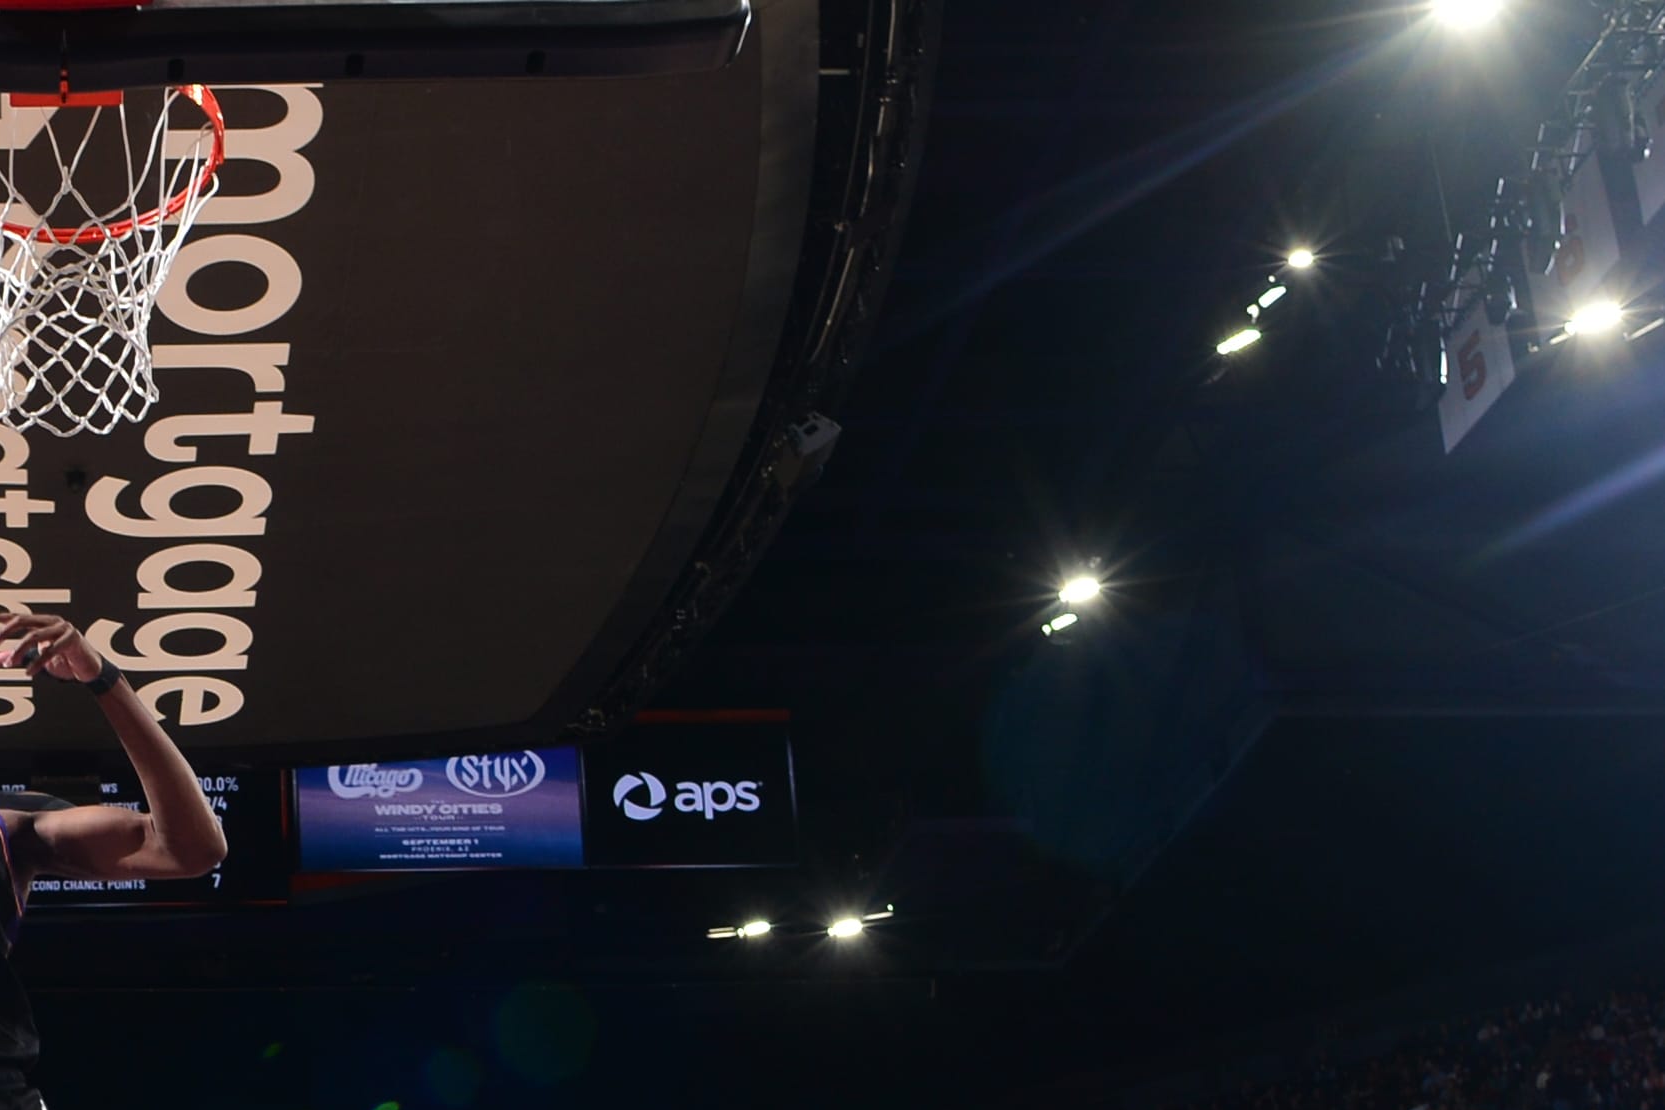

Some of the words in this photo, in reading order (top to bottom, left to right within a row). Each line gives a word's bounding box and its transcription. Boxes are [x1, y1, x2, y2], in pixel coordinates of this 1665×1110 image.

[85, 82, 325, 726] mortgage
[375, 804, 435, 816] WINDY
[438, 803, 503, 815] CITIES
[675, 780, 761, 820] aps
[29, 880, 61, 891] COND
[108, 879, 146, 889] POINTS
[211, 873, 222, 888] 7
